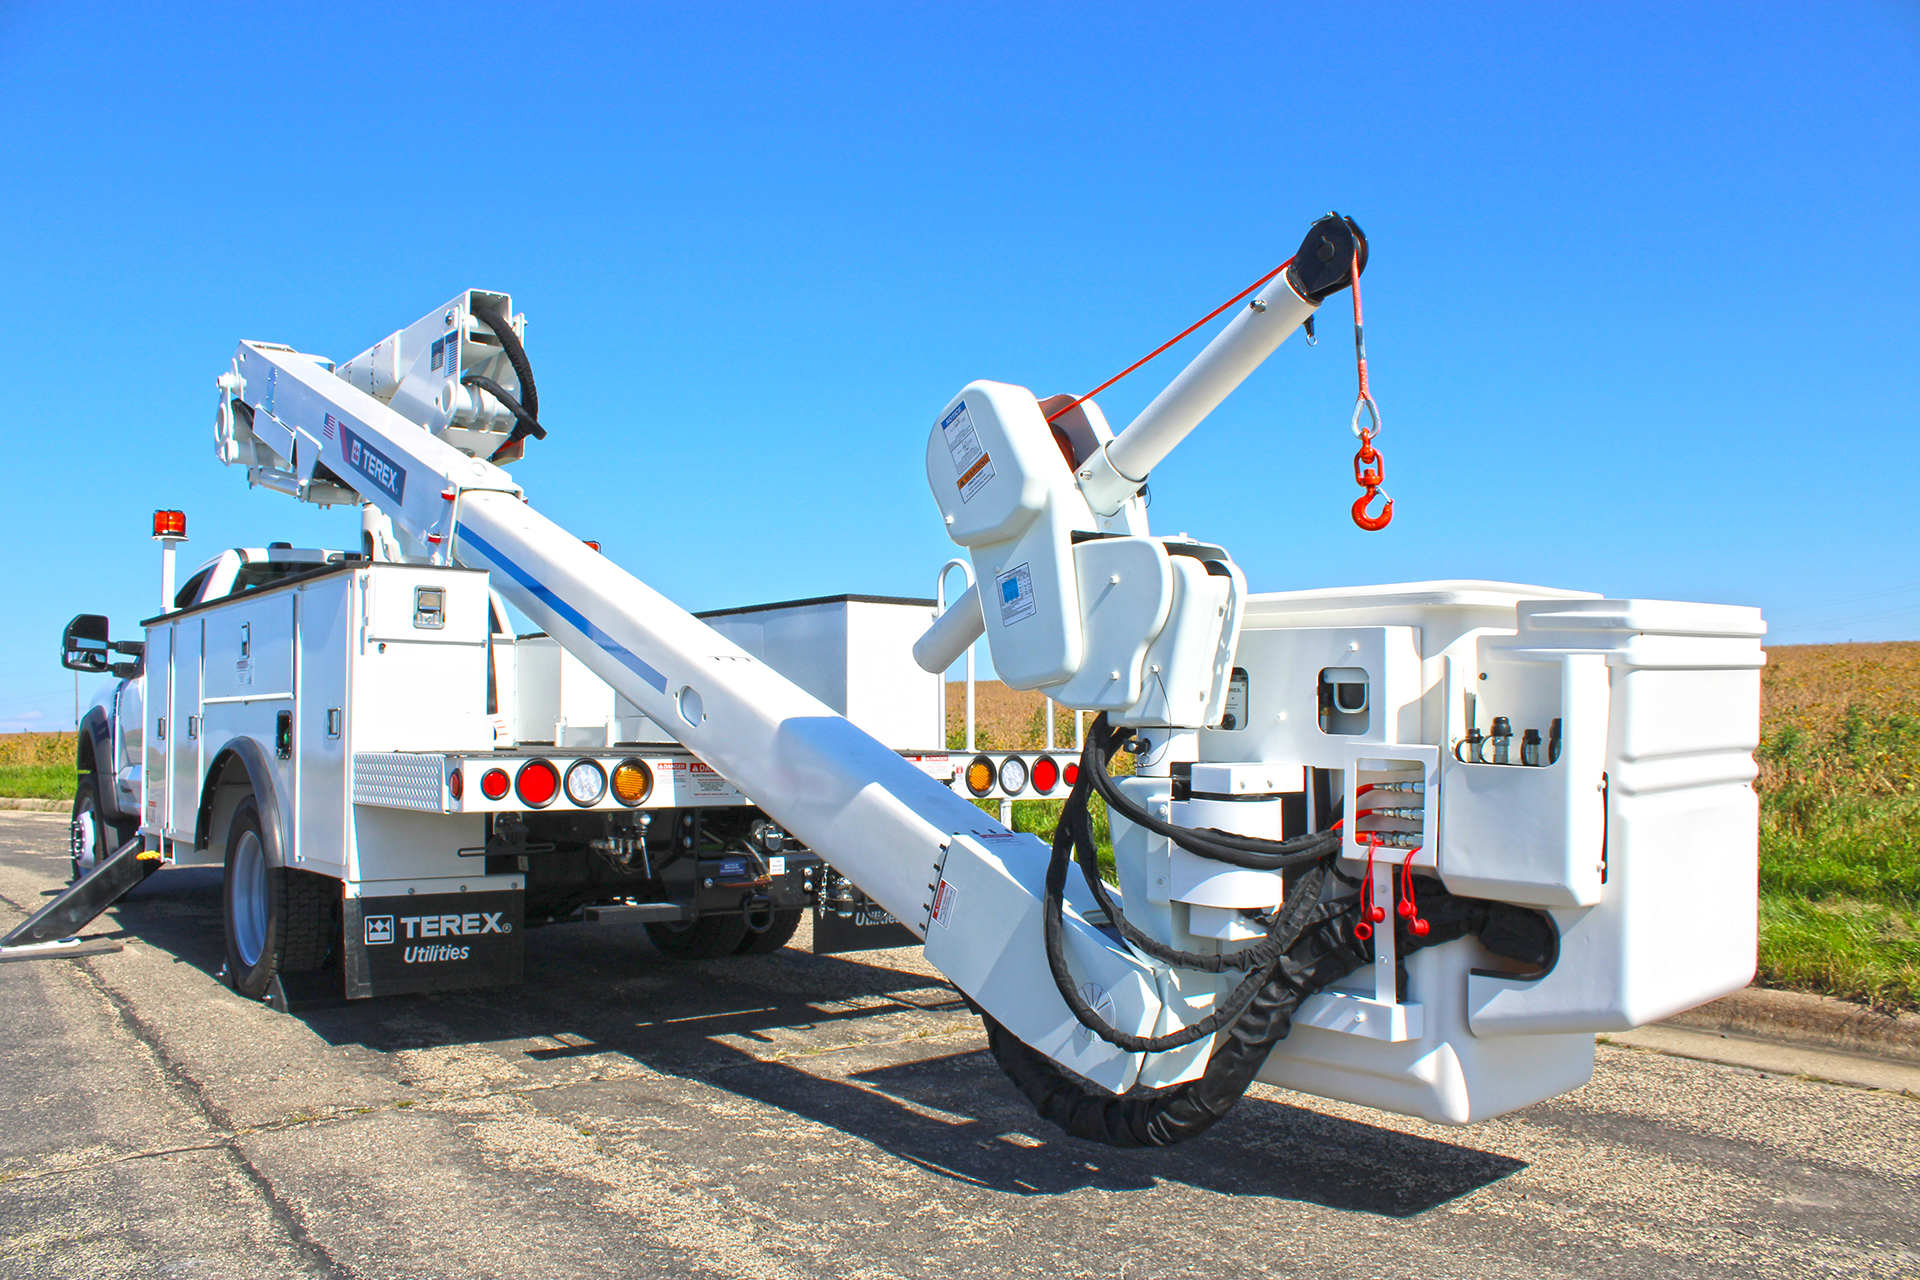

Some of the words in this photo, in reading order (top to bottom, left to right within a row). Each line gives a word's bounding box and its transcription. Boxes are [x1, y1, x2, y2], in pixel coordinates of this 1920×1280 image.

[945, 406, 962, 425] NOTICE
[363, 448, 398, 493] TEREX
[964, 456, 989, 480] WARNING
[400, 912, 503, 939] TEREX
[403, 944, 470, 964] Utilities
